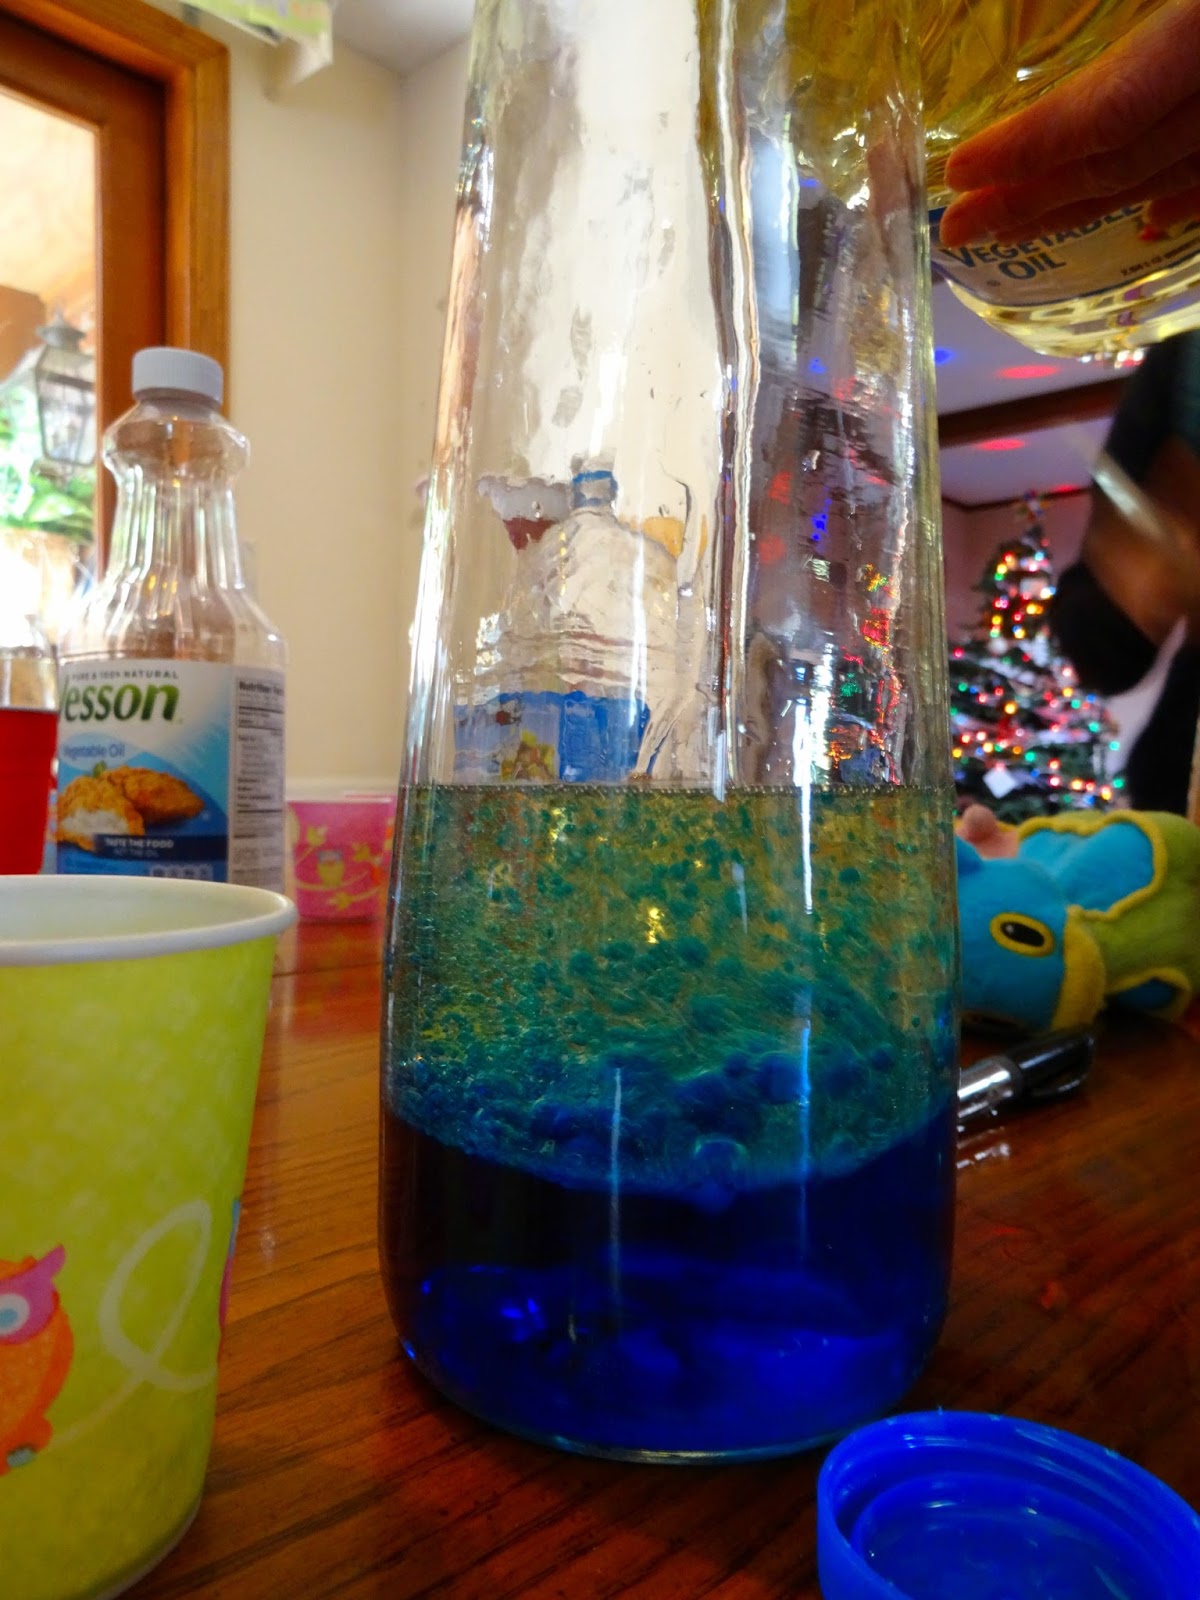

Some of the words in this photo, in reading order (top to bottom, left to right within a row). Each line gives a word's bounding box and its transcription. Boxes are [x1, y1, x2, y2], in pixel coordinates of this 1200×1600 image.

[998, 253, 1067, 280] OIL
[124, 670, 178, 679] NATURAL
[146, 839, 175, 849] FOOD
